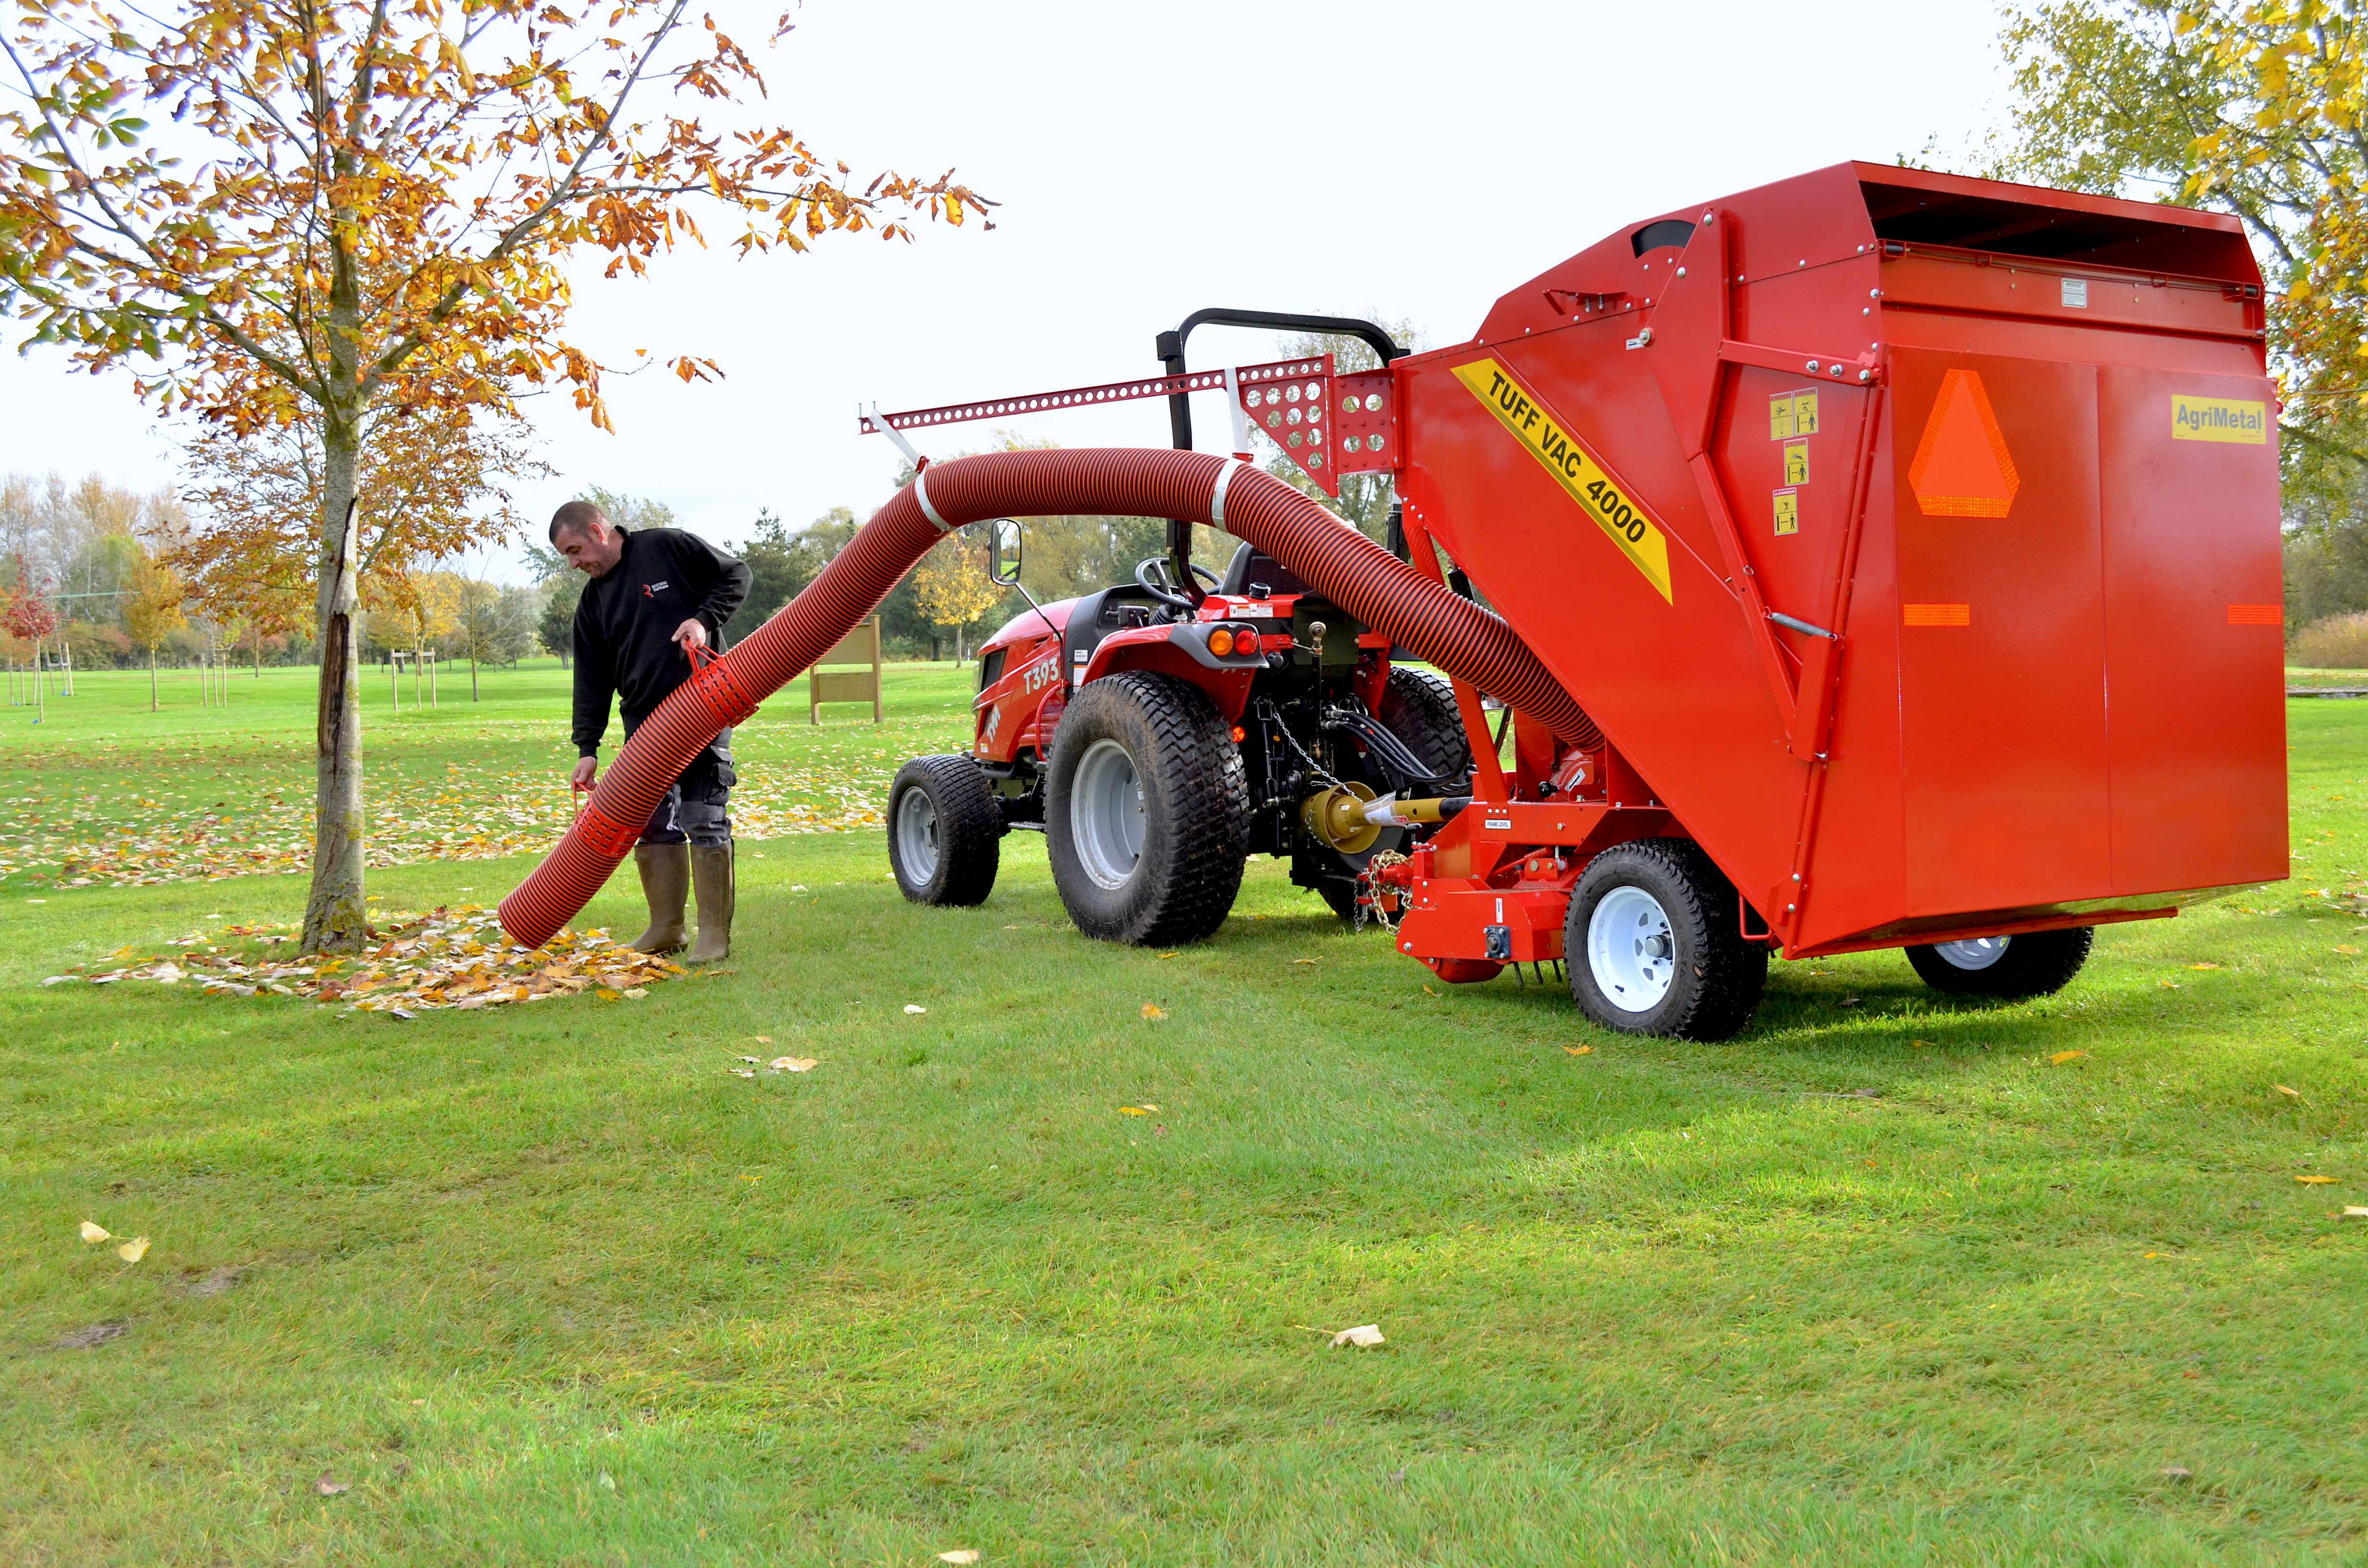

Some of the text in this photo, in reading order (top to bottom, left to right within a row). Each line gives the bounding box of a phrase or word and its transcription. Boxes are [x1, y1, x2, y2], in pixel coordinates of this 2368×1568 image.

[2176, 404, 2261, 431] AgriMetal
[1490, 371, 1646, 543] TUFF VAC 4000
[1023, 657, 1059, 695] T393
